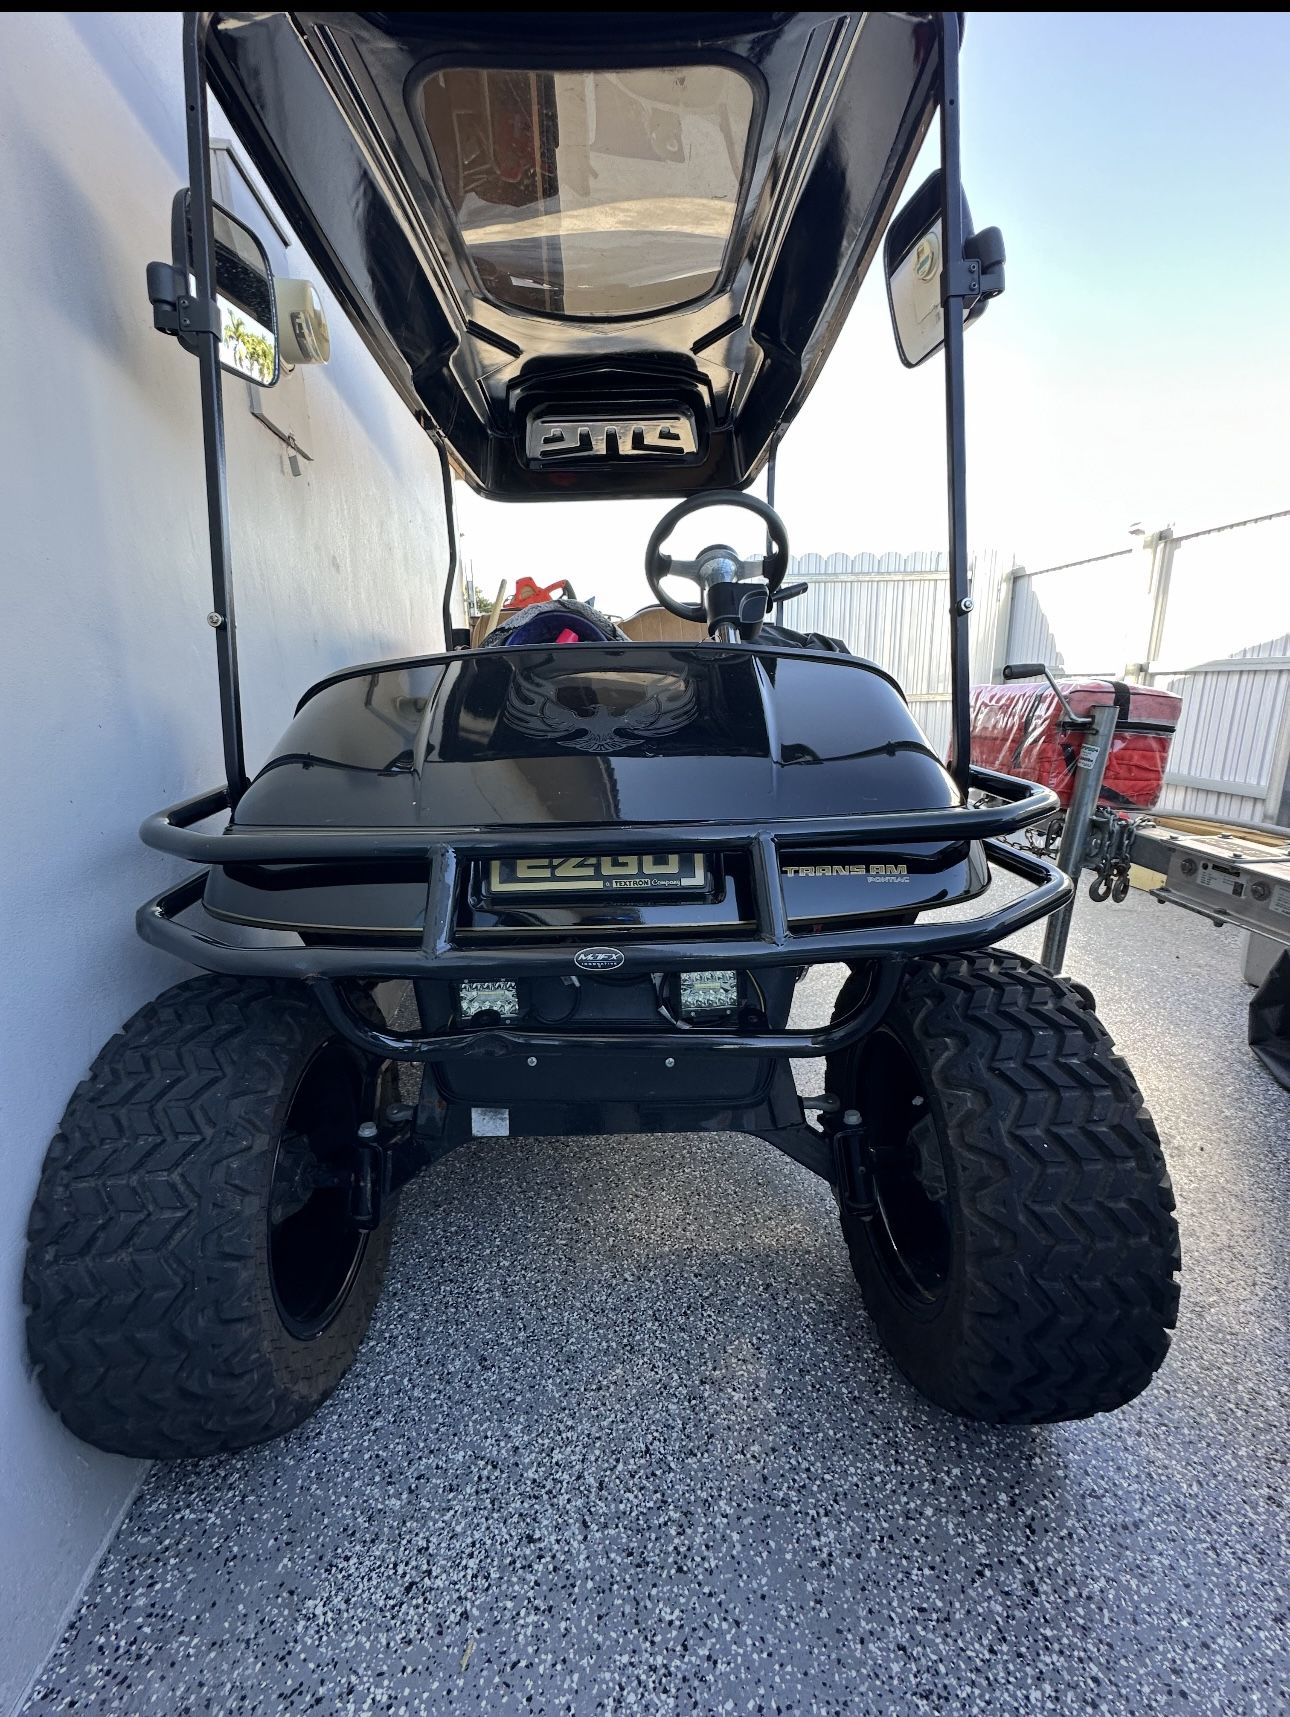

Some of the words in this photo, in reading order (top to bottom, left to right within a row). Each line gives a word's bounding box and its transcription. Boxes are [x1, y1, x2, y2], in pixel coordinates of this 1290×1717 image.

[782, 865, 866, 877] TRANS
[869, 864, 908, 875] AM
[652, 879, 681, 887] Company
